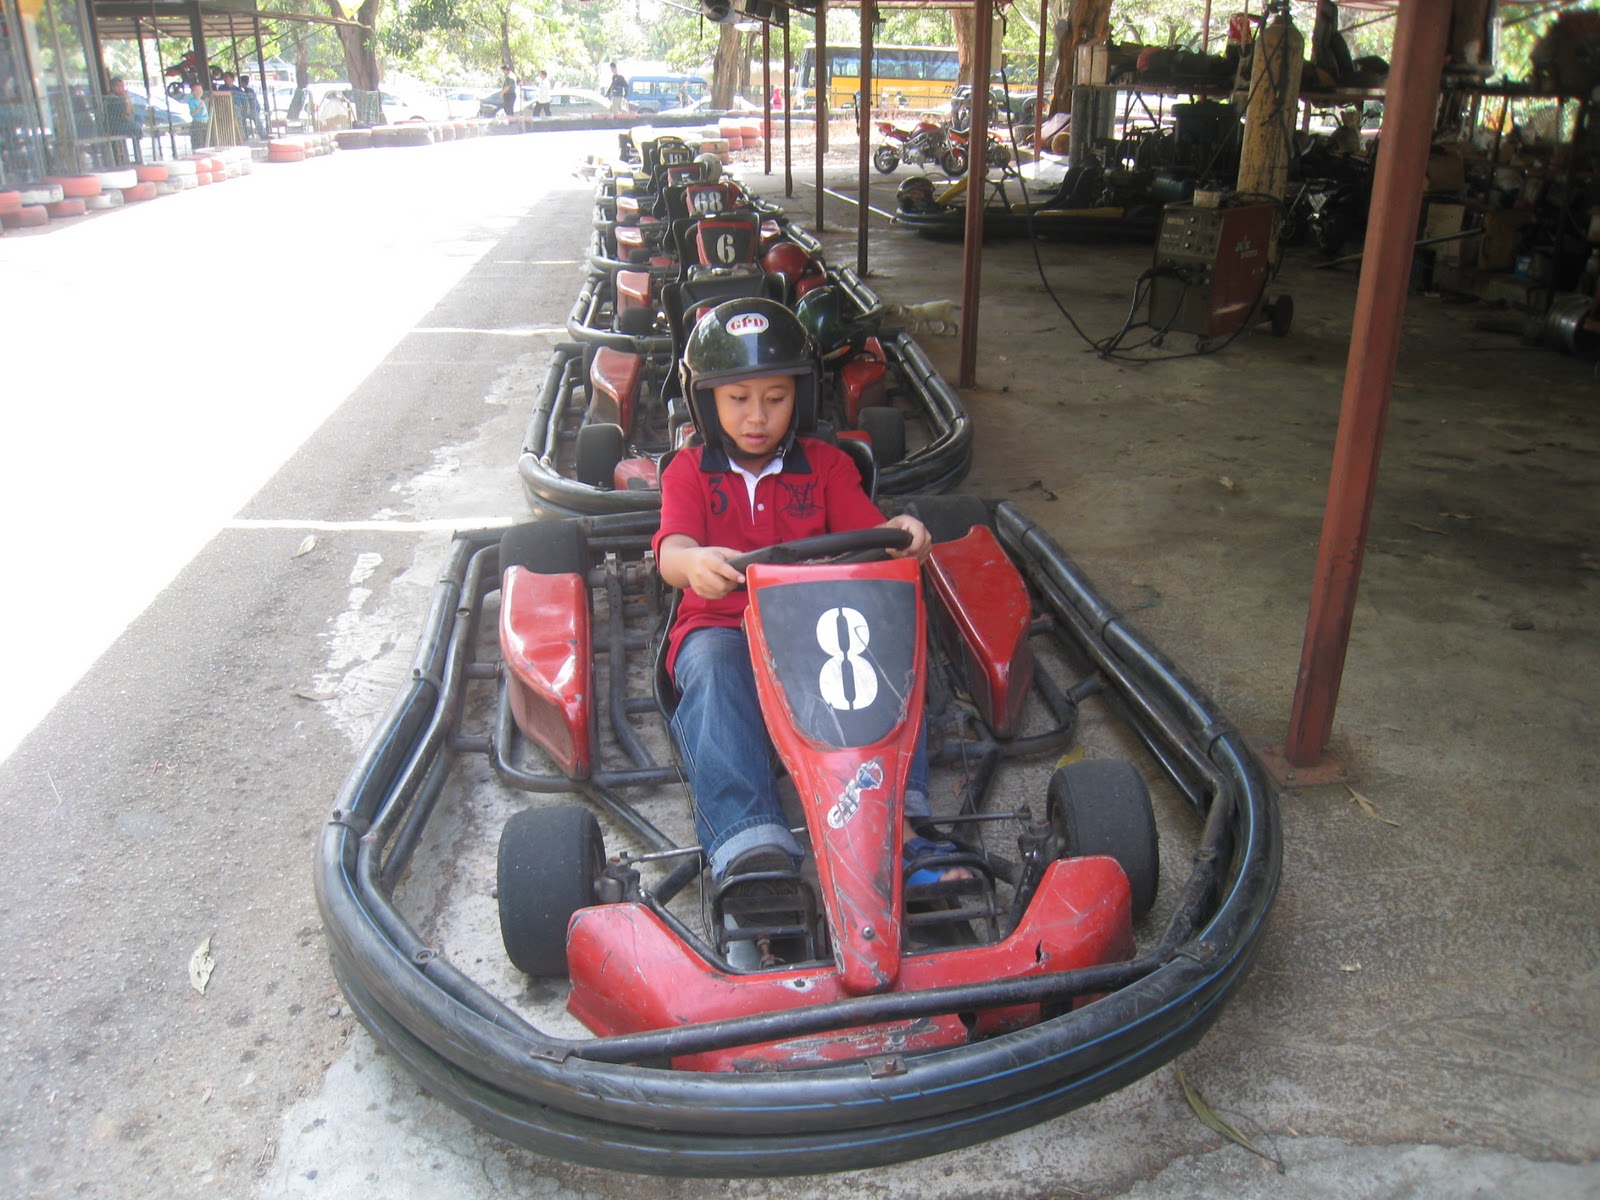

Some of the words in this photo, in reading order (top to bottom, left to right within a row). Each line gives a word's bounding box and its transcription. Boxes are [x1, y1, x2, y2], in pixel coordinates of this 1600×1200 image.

[694, 191, 723, 214] 68
[716, 233, 736, 263] 6
[731, 318, 764, 331] GPD
[708, 476, 728, 515] 3
[816, 607, 878, 710] 8
